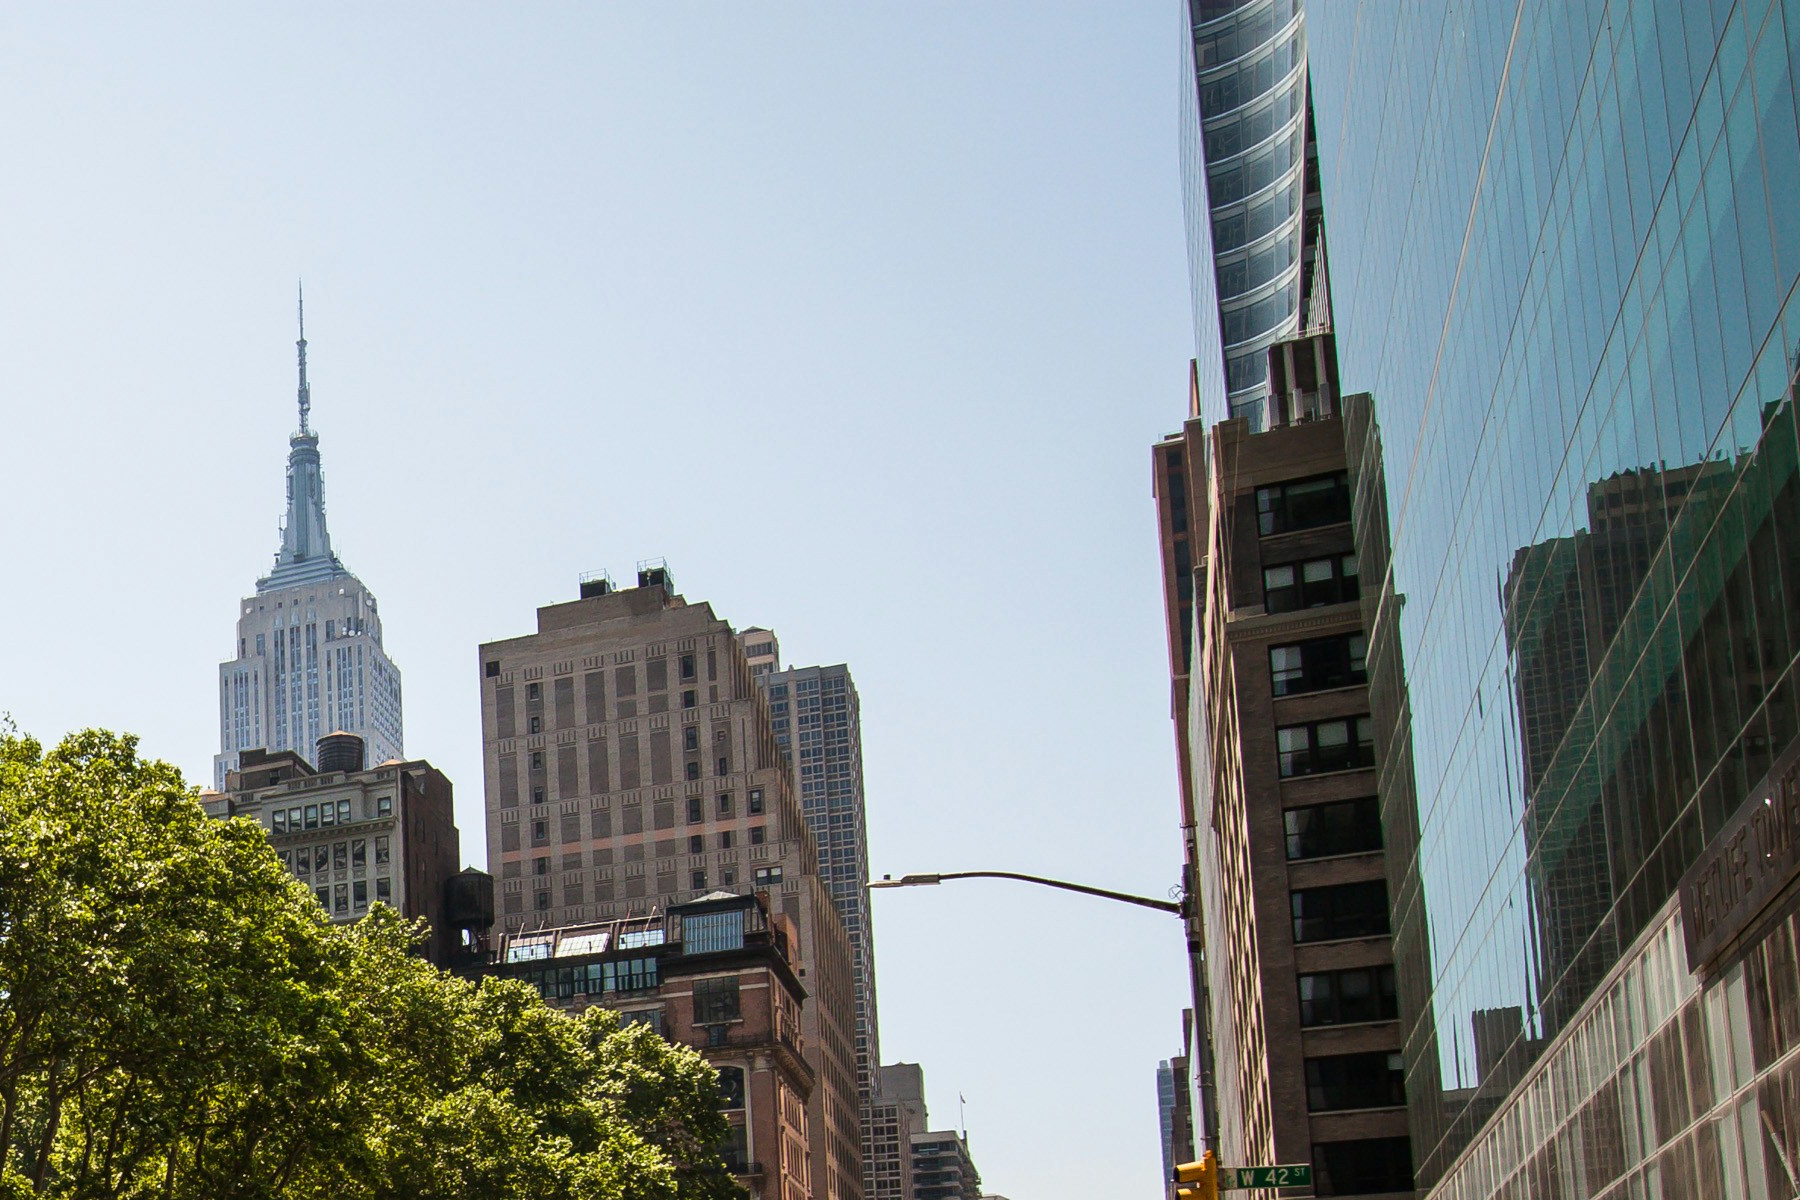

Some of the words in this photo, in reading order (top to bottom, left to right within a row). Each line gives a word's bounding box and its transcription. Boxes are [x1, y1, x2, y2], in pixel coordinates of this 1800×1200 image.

[1689, 824, 1752, 944] METLIFE
[1241, 1170, 1255, 1186] W
[1265, 1169, 1289, 1185] 42
[1294, 1168, 1306, 1177] ST
